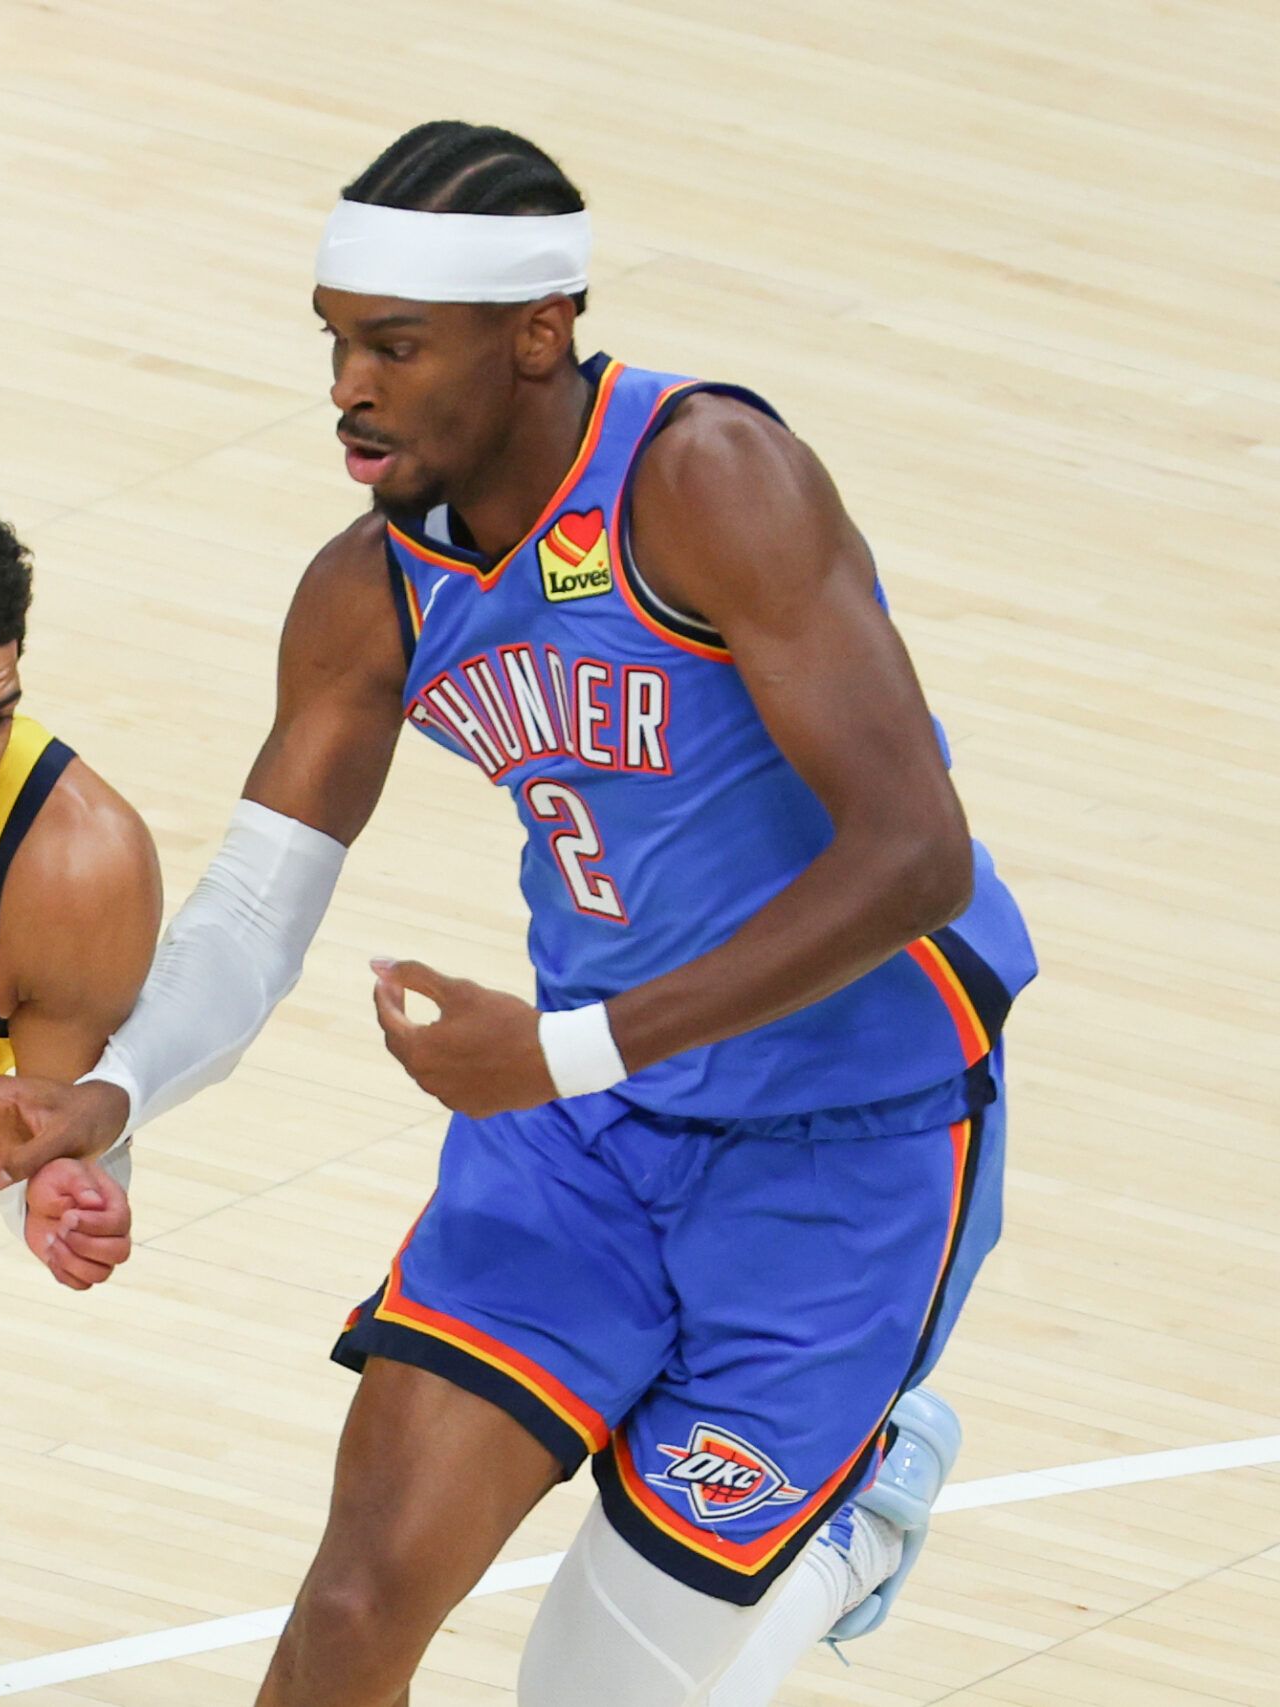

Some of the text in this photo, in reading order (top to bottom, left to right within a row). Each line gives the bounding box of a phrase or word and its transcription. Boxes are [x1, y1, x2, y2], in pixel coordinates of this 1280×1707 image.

[404, 641, 672, 783] THUNDER
[523, 777, 629, 925] 2
[670, 1452, 762, 1488] OKC
